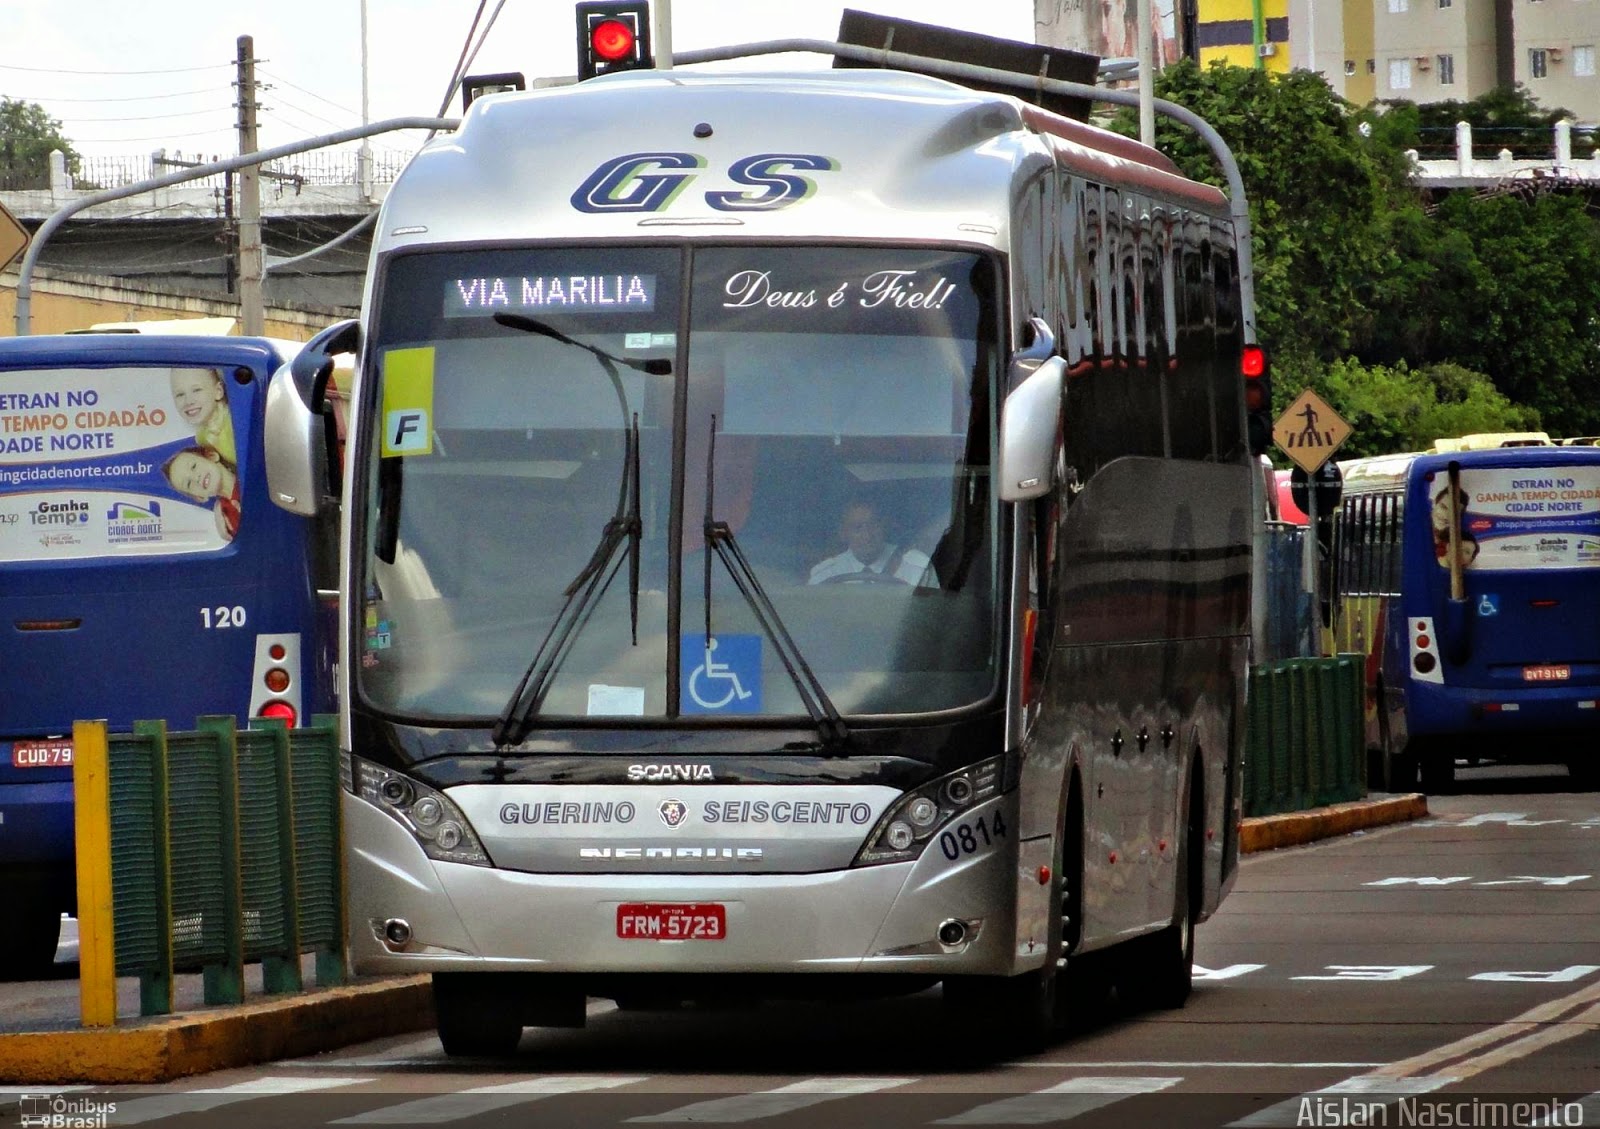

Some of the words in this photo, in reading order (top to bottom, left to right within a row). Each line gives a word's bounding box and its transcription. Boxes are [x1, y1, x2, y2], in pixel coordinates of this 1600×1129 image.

[457, 278, 509, 307] VIA
[522, 276, 648, 304] MARILIA
[723, 270, 819, 308] Deus
[827, 282, 849, 308] é
[859, 270, 957, 309] Fiel!
[67, 389, 99, 408] NO
[2, 412, 69, 433] TEMPO
[74, 404, 167, 430] CIDADÃO
[394, 414, 421, 446] F
[50, 432, 115, 451] NORTE
[1512, 479, 1553, 490] DETRAN
[1557, 478, 1575, 488] NO
[38, 500, 89, 514] Ganha
[1476, 491, 1518, 503] GANHA
[1521, 490, 1558, 501] TEMPO
[1505, 502, 1545, 513] CIDADE
[1548, 501, 1584, 512] NORTE
[200, 606, 247, 629] 120
[627, 764, 714, 782] SCANIA
[499, 802, 636, 825] GUERINO
[702, 801, 872, 825] SEISCENTO
[940, 810, 1007, 861] 0814
